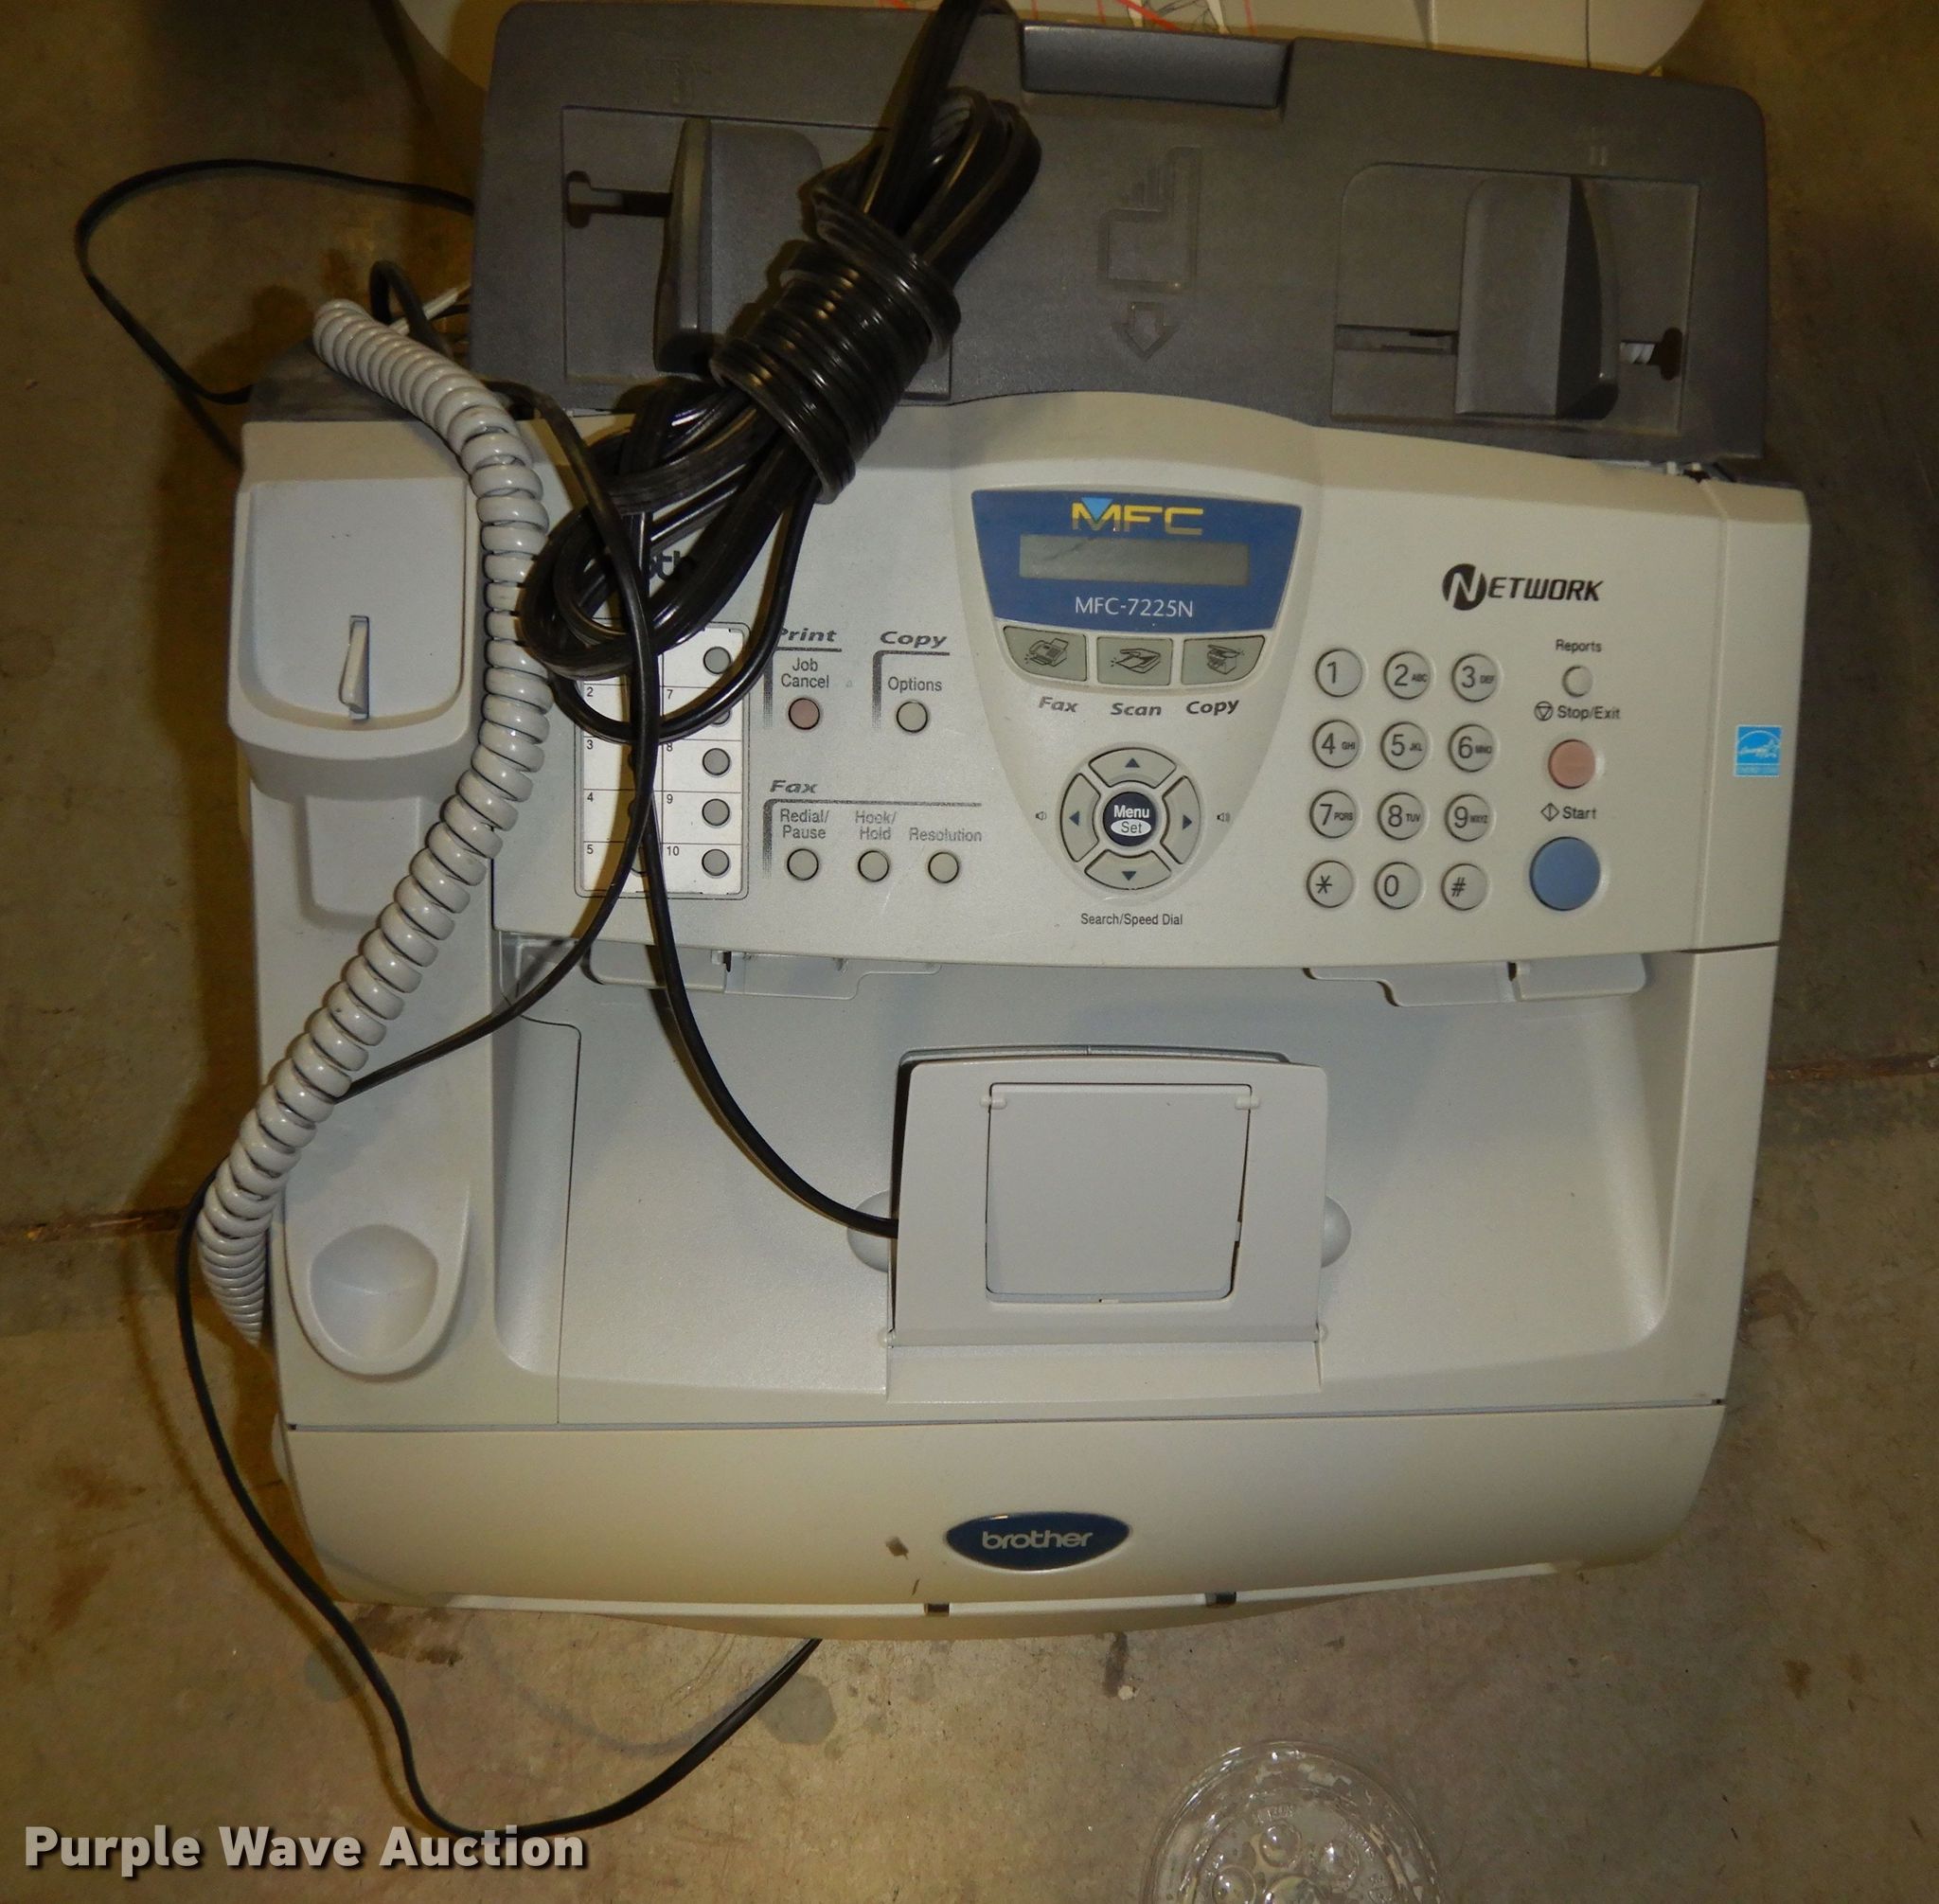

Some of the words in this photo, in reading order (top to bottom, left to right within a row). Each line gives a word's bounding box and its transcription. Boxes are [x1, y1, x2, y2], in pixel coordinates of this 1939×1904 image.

[1071, 503, 1204, 536] MFC
[1442, 563, 1604, 612] NETWORK
[1075, 596, 1194, 618] MFC-7225N
[880, 631, 949, 649] Copy
[1556, 638, 1602, 653] Reports
[792, 657, 819, 672] Job
[780, 673, 829, 689] Cancel
[1326, 661, 1337, 685] 1
[1394, 663, 1409, 686] 2
[1461, 666, 1476, 688] 3
[586, 686, 594, 698] 2
[887, 676, 943, 694] Options
[667, 688, 674, 700] 7
[1038, 696, 1078, 714] Fax
[1110, 702, 1163, 717] Scan
[1185, 699, 1240, 717] Copy
[1557, 704, 1621, 721] Stop/Exit
[586, 739, 594, 751] 3
[1321, 732, 1336, 755] 4
[1391, 734, 1406, 756] 5
[1459, 736, 1473, 759] 6
[769, 779, 819, 795] Fax
[586, 792, 594, 803] 4
[666, 793, 674, 805] 9
[779, 809, 829, 824] Redial/
[854, 810, 897, 825] Hook/
[1113, 805, 1150, 819] Menu
[1319, 803, 1333, 826] 7
[1387, 805, 1403, 827] 8
[1453, 806, 1468, 828] 9
[1562, 806, 1597, 820] Start
[782, 825, 827, 840] Pause
[860, 827, 892, 841] Hold
[908, 827, 983, 842] Resolution
[1120, 820, 1143, 834] Set
[586, 845, 594, 855] 5
[667, 845, 680, 857] 10
[1383, 873, 1399, 898] 0
[1450, 876, 1467, 898] #
[1080, 912, 1159, 926] Search/Speed
[1162, 912, 1183, 926] Dial
[982, 1530, 1094, 1550] brother
